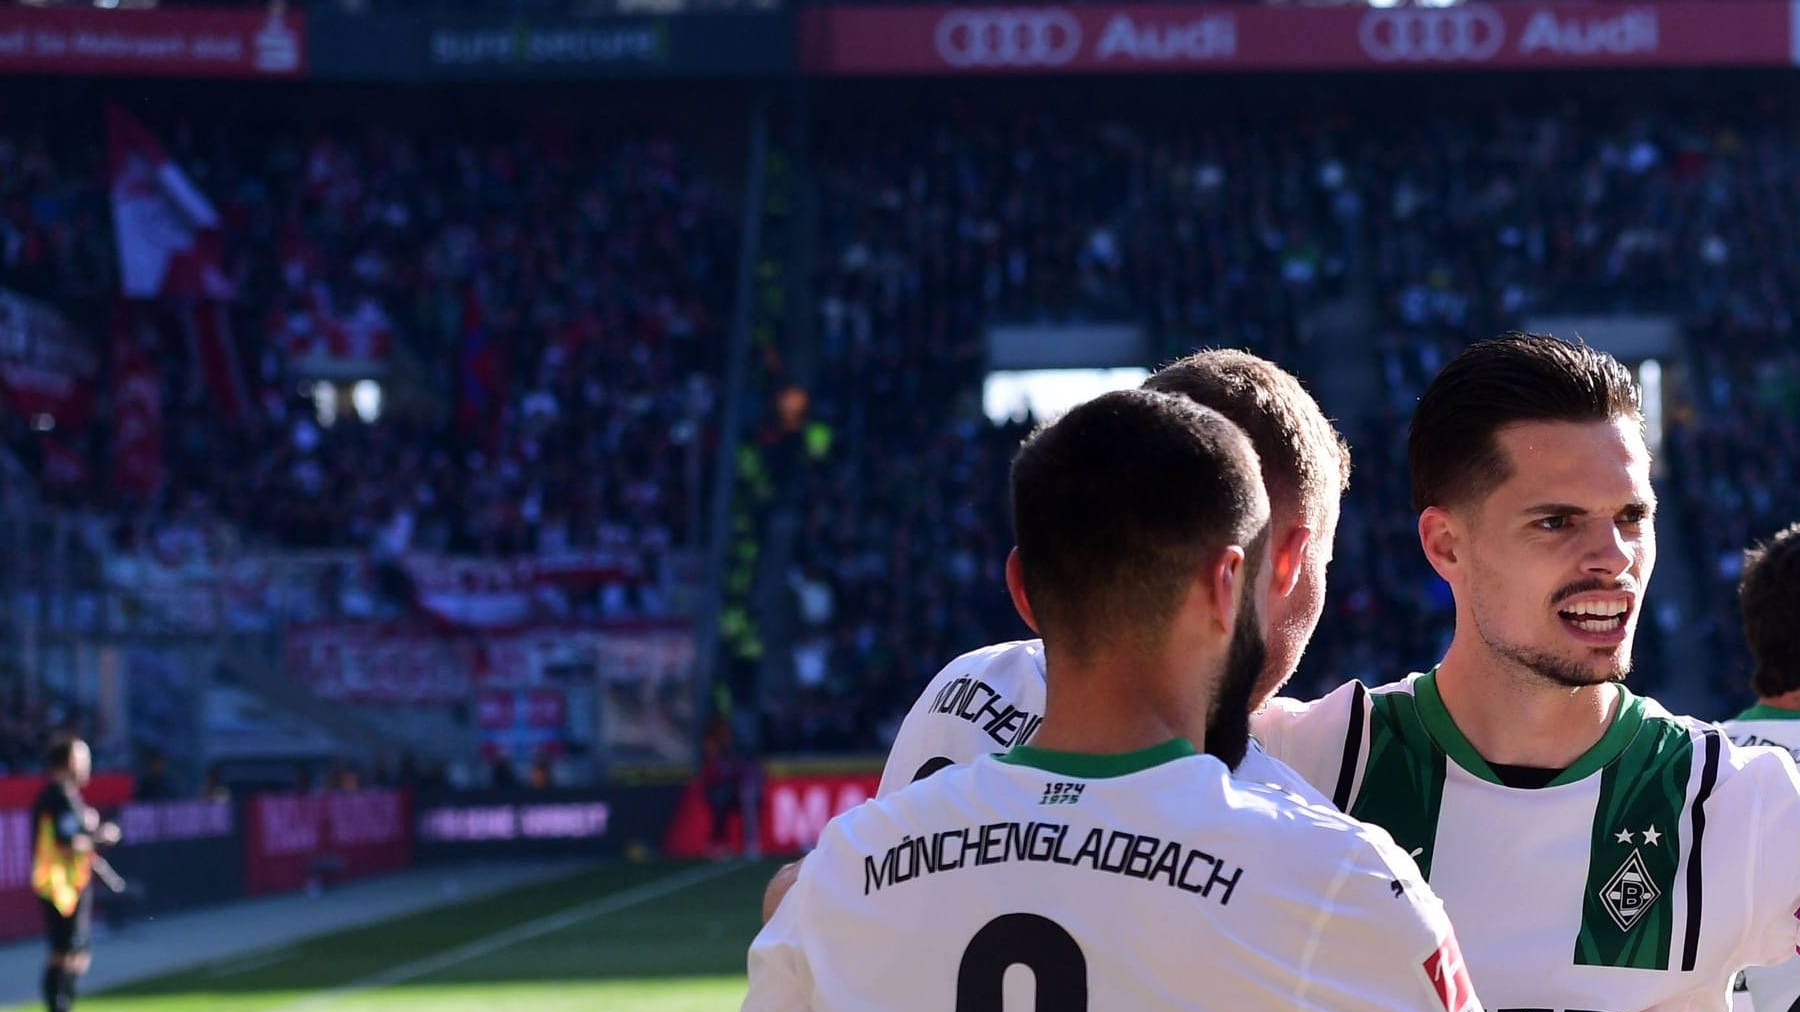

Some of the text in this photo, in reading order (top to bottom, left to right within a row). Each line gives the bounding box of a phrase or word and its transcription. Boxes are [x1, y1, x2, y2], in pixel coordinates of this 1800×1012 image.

[1096, 12, 1238, 60] Audi
[1517, 8, 1659, 55] Audi
[1044, 783, 1085, 795] 1974
[864, 821, 1243, 905] MÖNCHENGLADBACH
